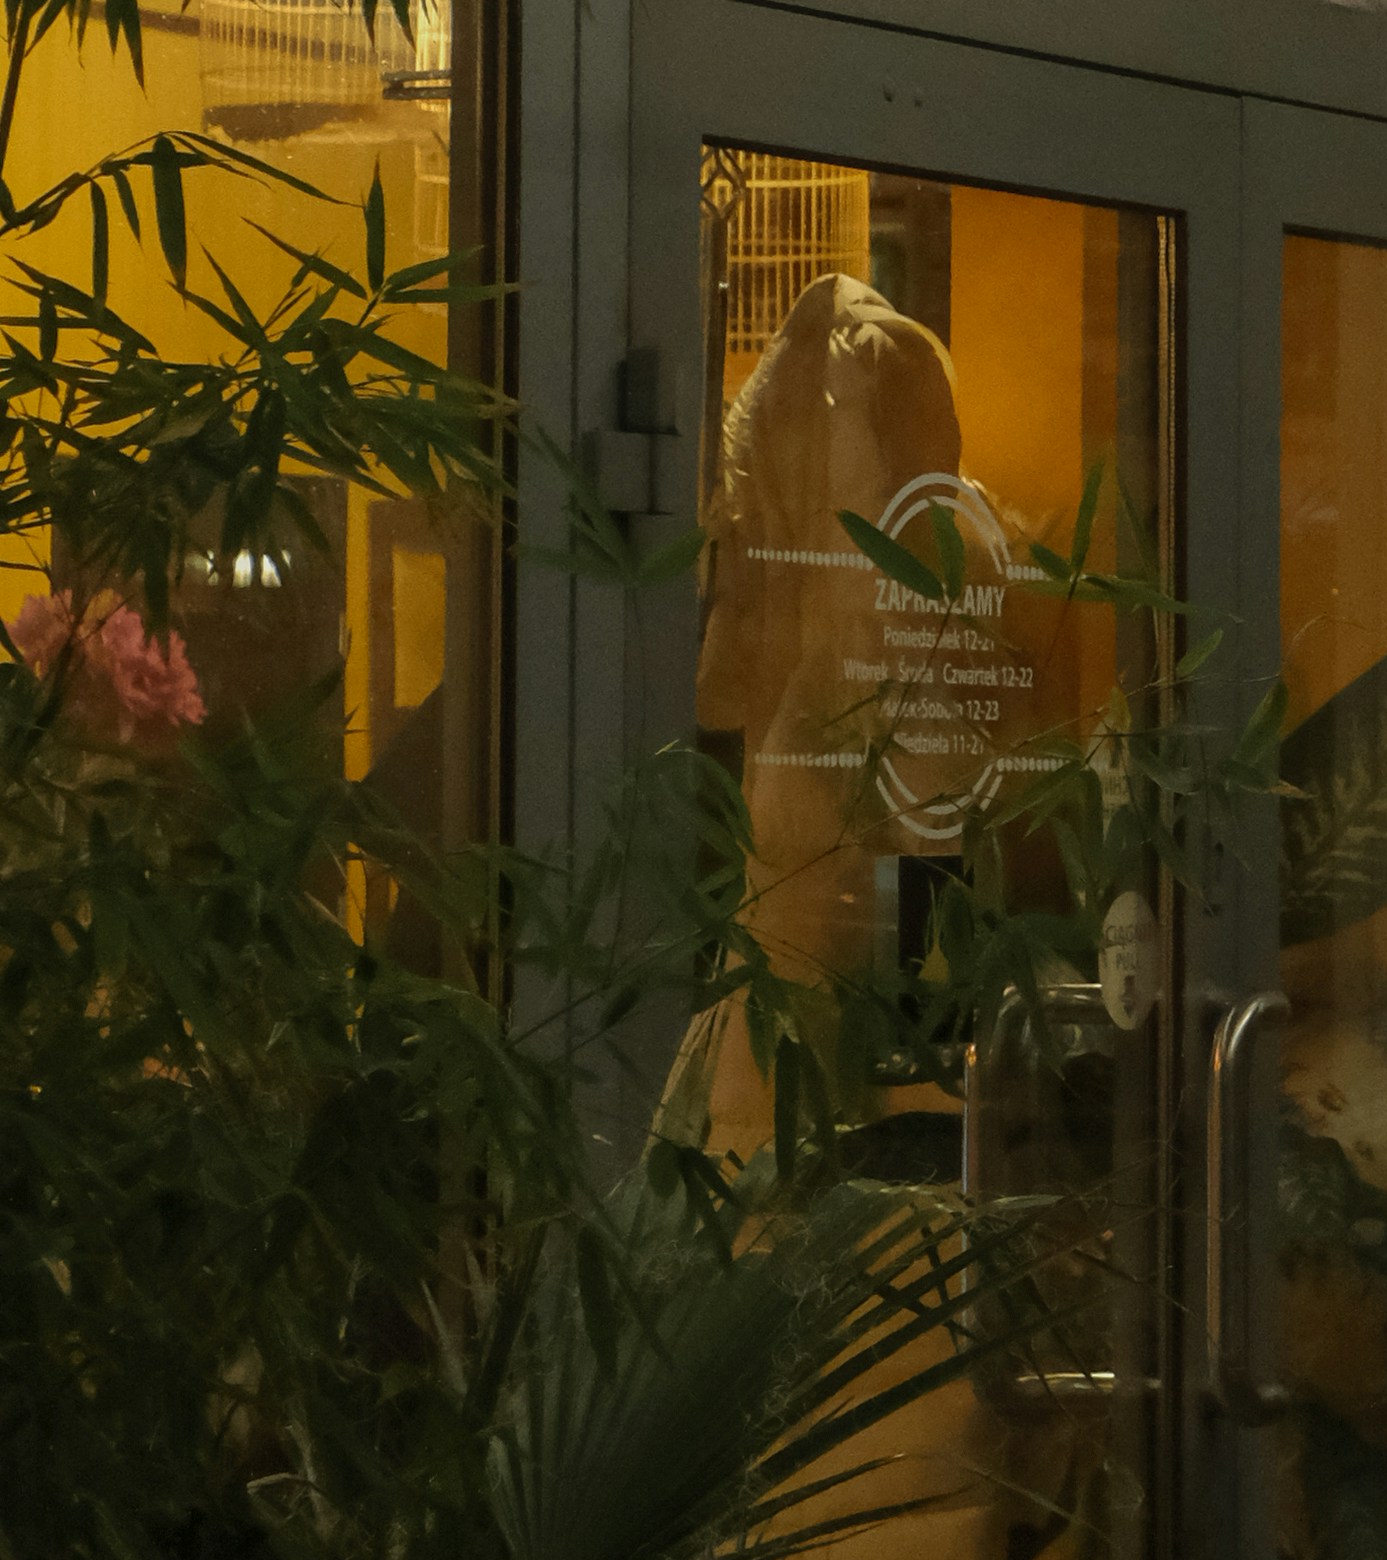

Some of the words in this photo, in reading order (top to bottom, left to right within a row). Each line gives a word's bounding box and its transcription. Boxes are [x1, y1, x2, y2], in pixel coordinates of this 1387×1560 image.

[943, 663, 998, 687] Czwartek
[1001, 667, 1034, 688] 12-22
[966, 700, 1000, 721] 12-23
